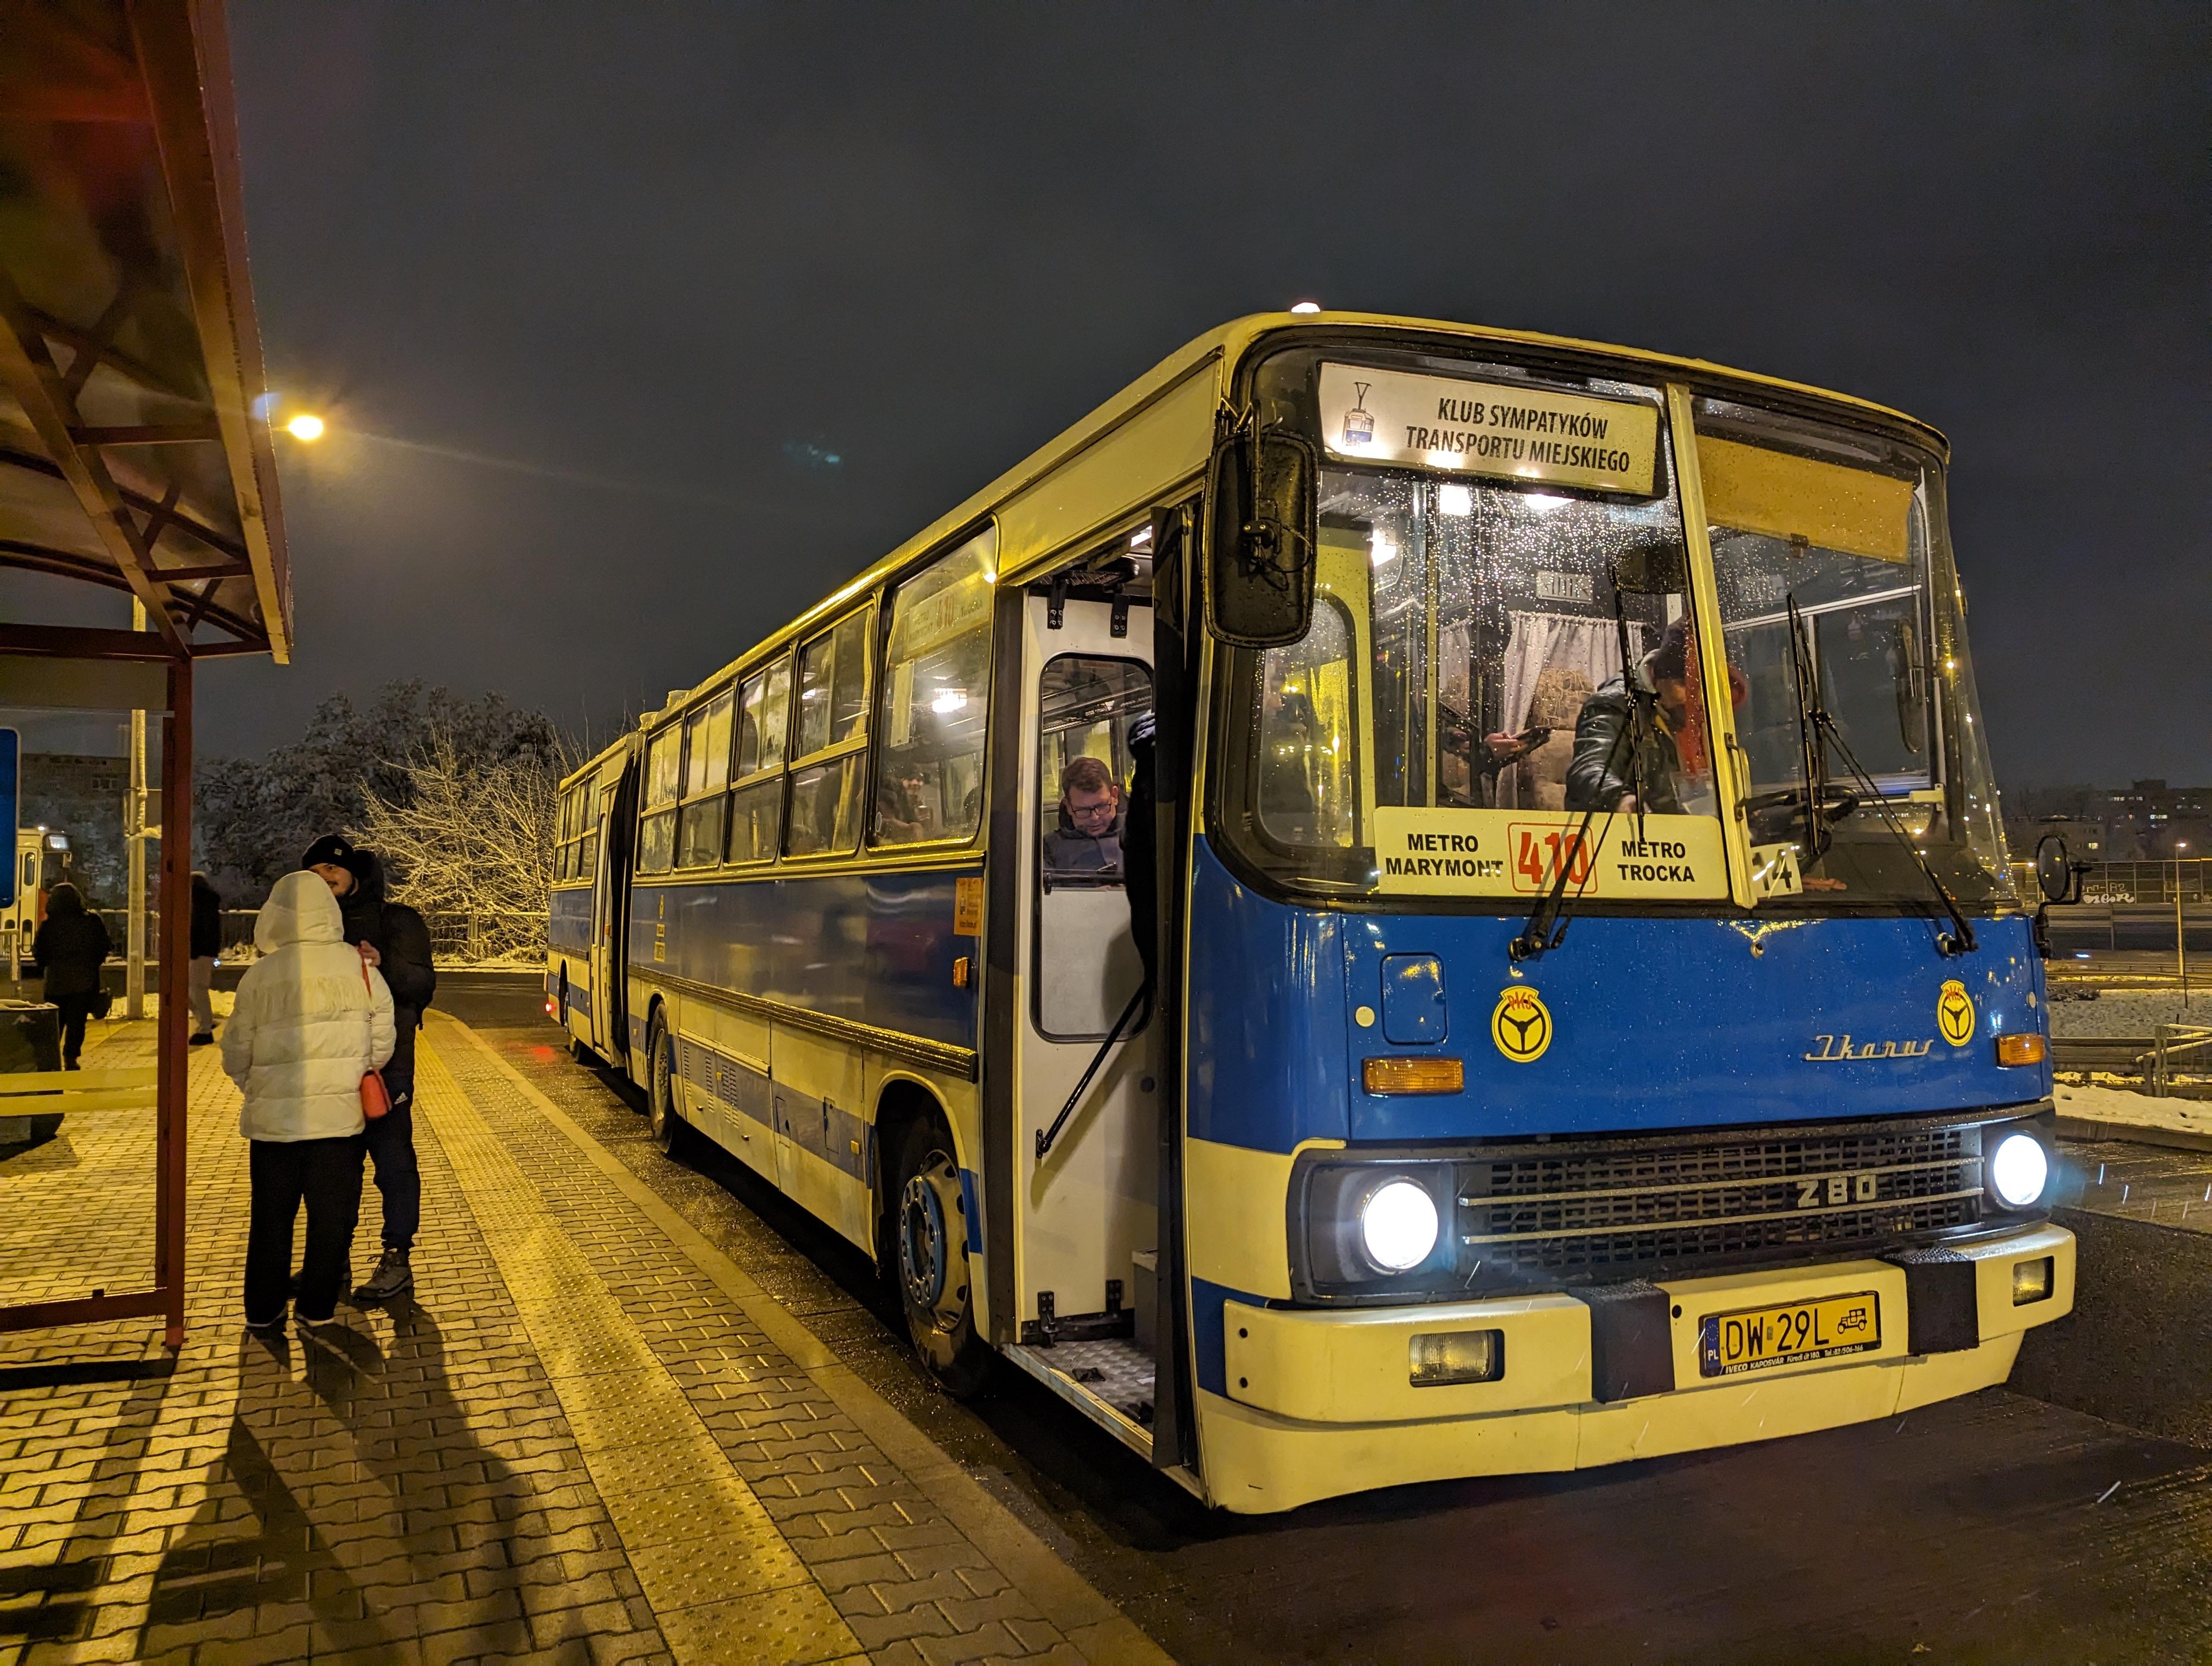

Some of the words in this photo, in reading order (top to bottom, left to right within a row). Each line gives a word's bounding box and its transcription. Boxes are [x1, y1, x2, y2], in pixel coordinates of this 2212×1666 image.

[1438, 398, 1484, 424] KLUB
[1489, 405, 1609, 440] SYMPATYKÓW
[1406, 426, 1525, 460] TRANSPORTU
[1529, 440, 1630, 472] MIEJSKIEGO
[1407, 833, 1479, 853] METRO
[1622, 840, 1686, 859] METRO
[1386, 857, 1503, 877] MARYMONT
[1518, 831, 1590, 885] 410
[1617, 864, 1695, 883] TROCKA
[1752, 848, 1792, 890] 14
[1507, 991, 1534, 1011] PKS
[1805, 1035, 1934, 1061] Ikarus
[1726, 1316, 1764, 1360] DW
[1777, 1308, 1830, 1353] 29L
[1708, 1349, 1719, 1361] PL
[1725, 1363, 1748, 1374] IVECO
[1750, 1357, 1784, 1369] KAPOSVÁR
